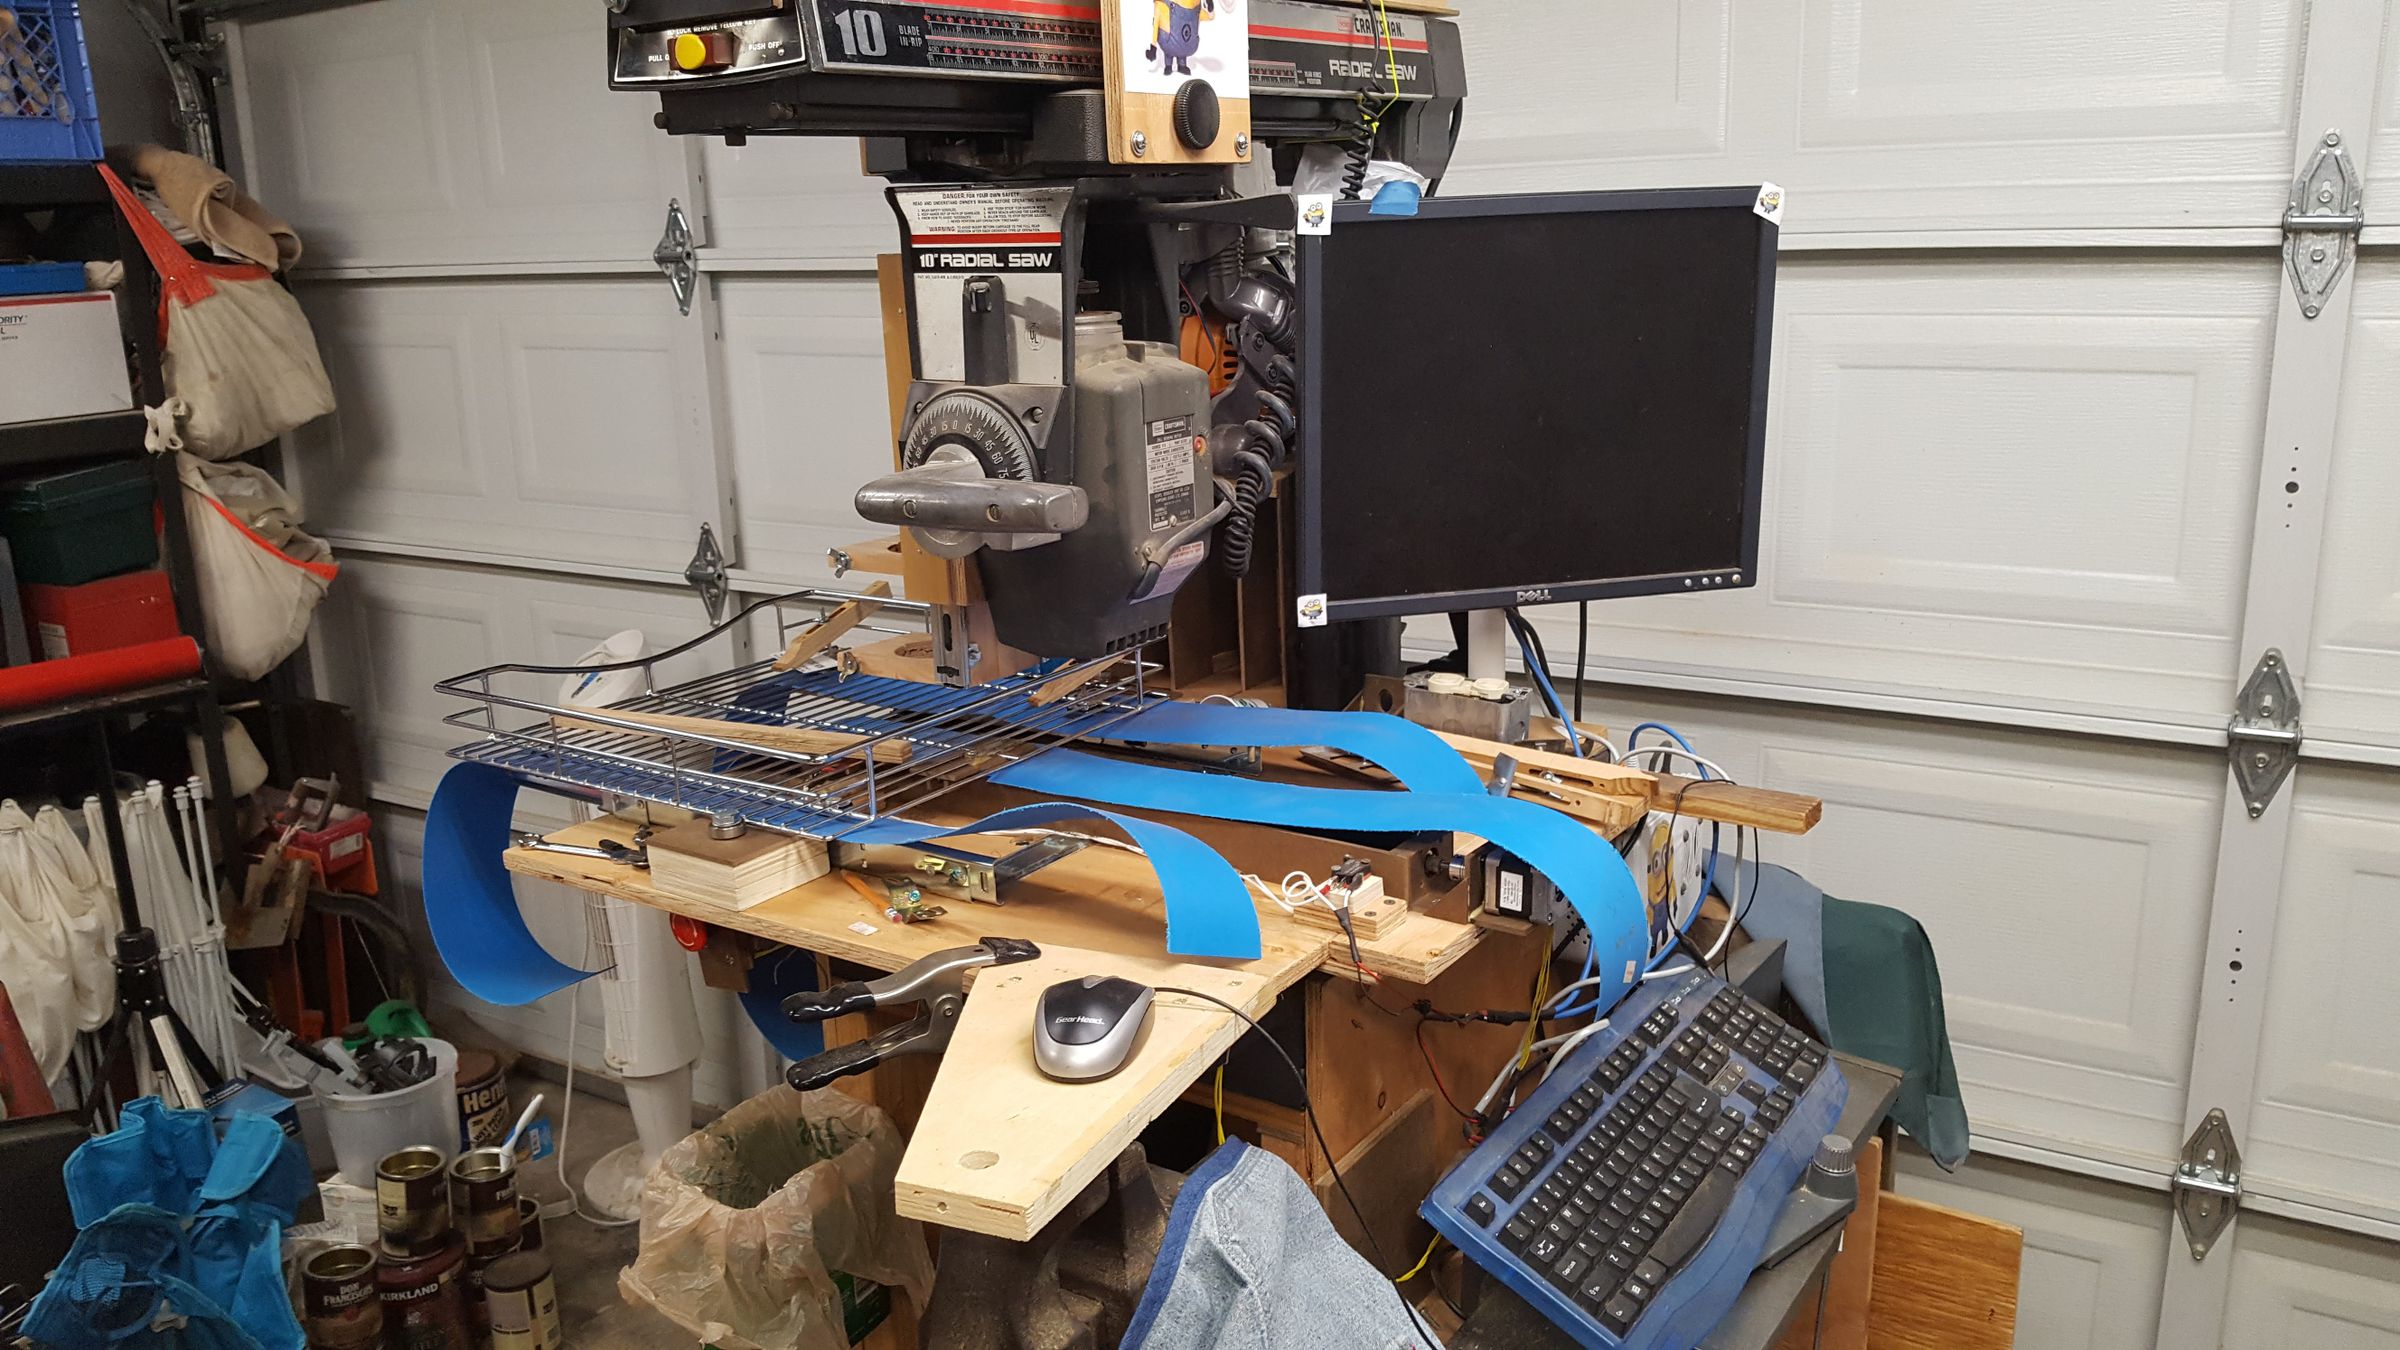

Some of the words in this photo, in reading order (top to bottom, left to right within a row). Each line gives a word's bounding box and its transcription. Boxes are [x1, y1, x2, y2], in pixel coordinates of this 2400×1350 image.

[676, 27, 692, 35] LOCK
[720, 21, 743, 29] YELLOW
[835, 9, 887, 56] 10
[898, 24, 920, 36] BLADE
[749, 42, 766, 51] PUSH
[768, 41, 780, 49] OFF
[899, 36, 923, 47] IN-RIP
[940, 253, 1005, 268] RADIAL
[1008, 252, 1053, 268] SAW
[929, 426, 937, 436] 30
[941, 421, 948, 431] 15
[952, 420, 958, 430] 0
[964, 423, 972, 434] 15
[974, 428, 985, 440] 30
[984, 439, 996, 452] 45
[991, 453, 1004, 465] 60
[997, 467, 1010, 479] 75
[1516, 589, 1551, 602] DELL
[379, 1283, 439, 1301] KIRKLAND
